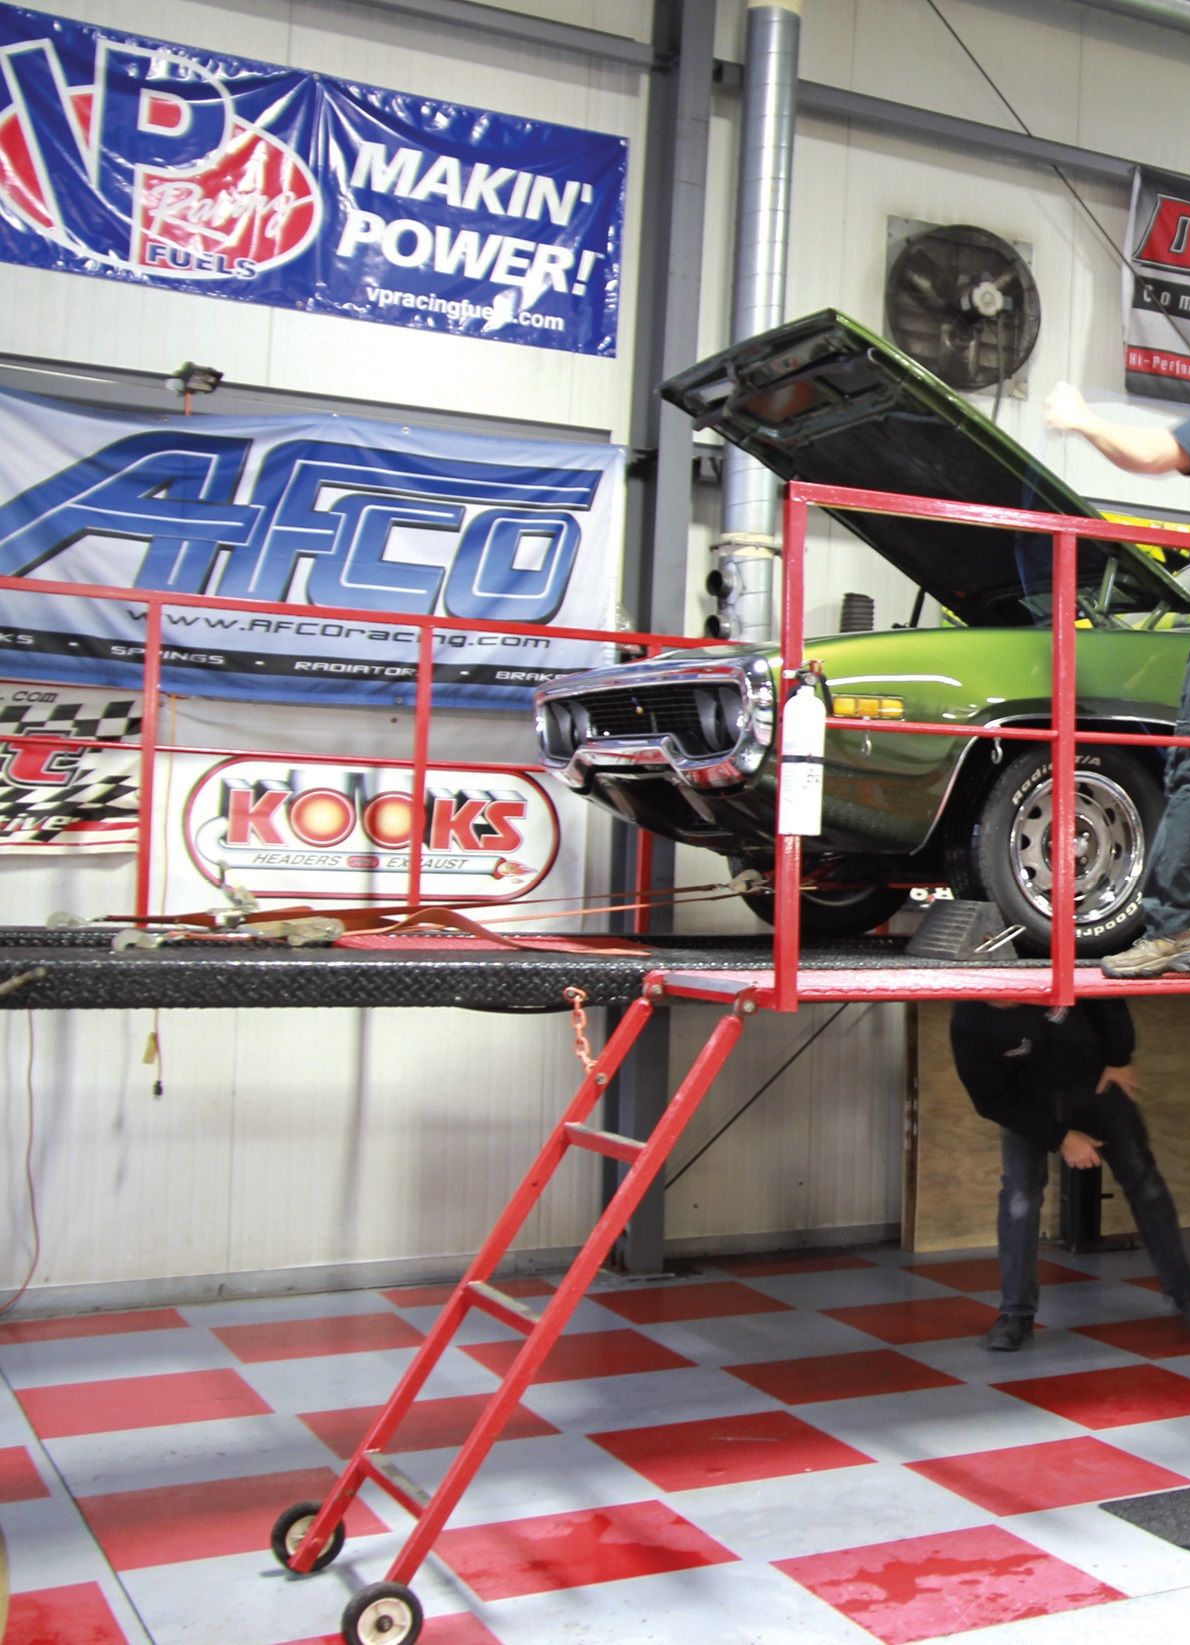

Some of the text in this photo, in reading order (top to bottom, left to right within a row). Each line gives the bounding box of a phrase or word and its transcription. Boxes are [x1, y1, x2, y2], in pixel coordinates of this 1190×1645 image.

[350, 141, 593, 227] MAKIN'
[146, 242, 258, 280] FUELS
[336, 209, 599, 297] POWER!
[366, 285, 565, 331] vpracingfue.com
[0, 430, 603, 624] AFCO
[126, 608, 552, 649] www.AFCOracng.com
[110, 645, 227, 666] SPINGS
[294, 660, 419, 678] RADIATOR
[221, 785, 527, 853] KOOKS
[252, 853, 342, 867] HEADERS
[386, 857, 470, 870] EXAUST
